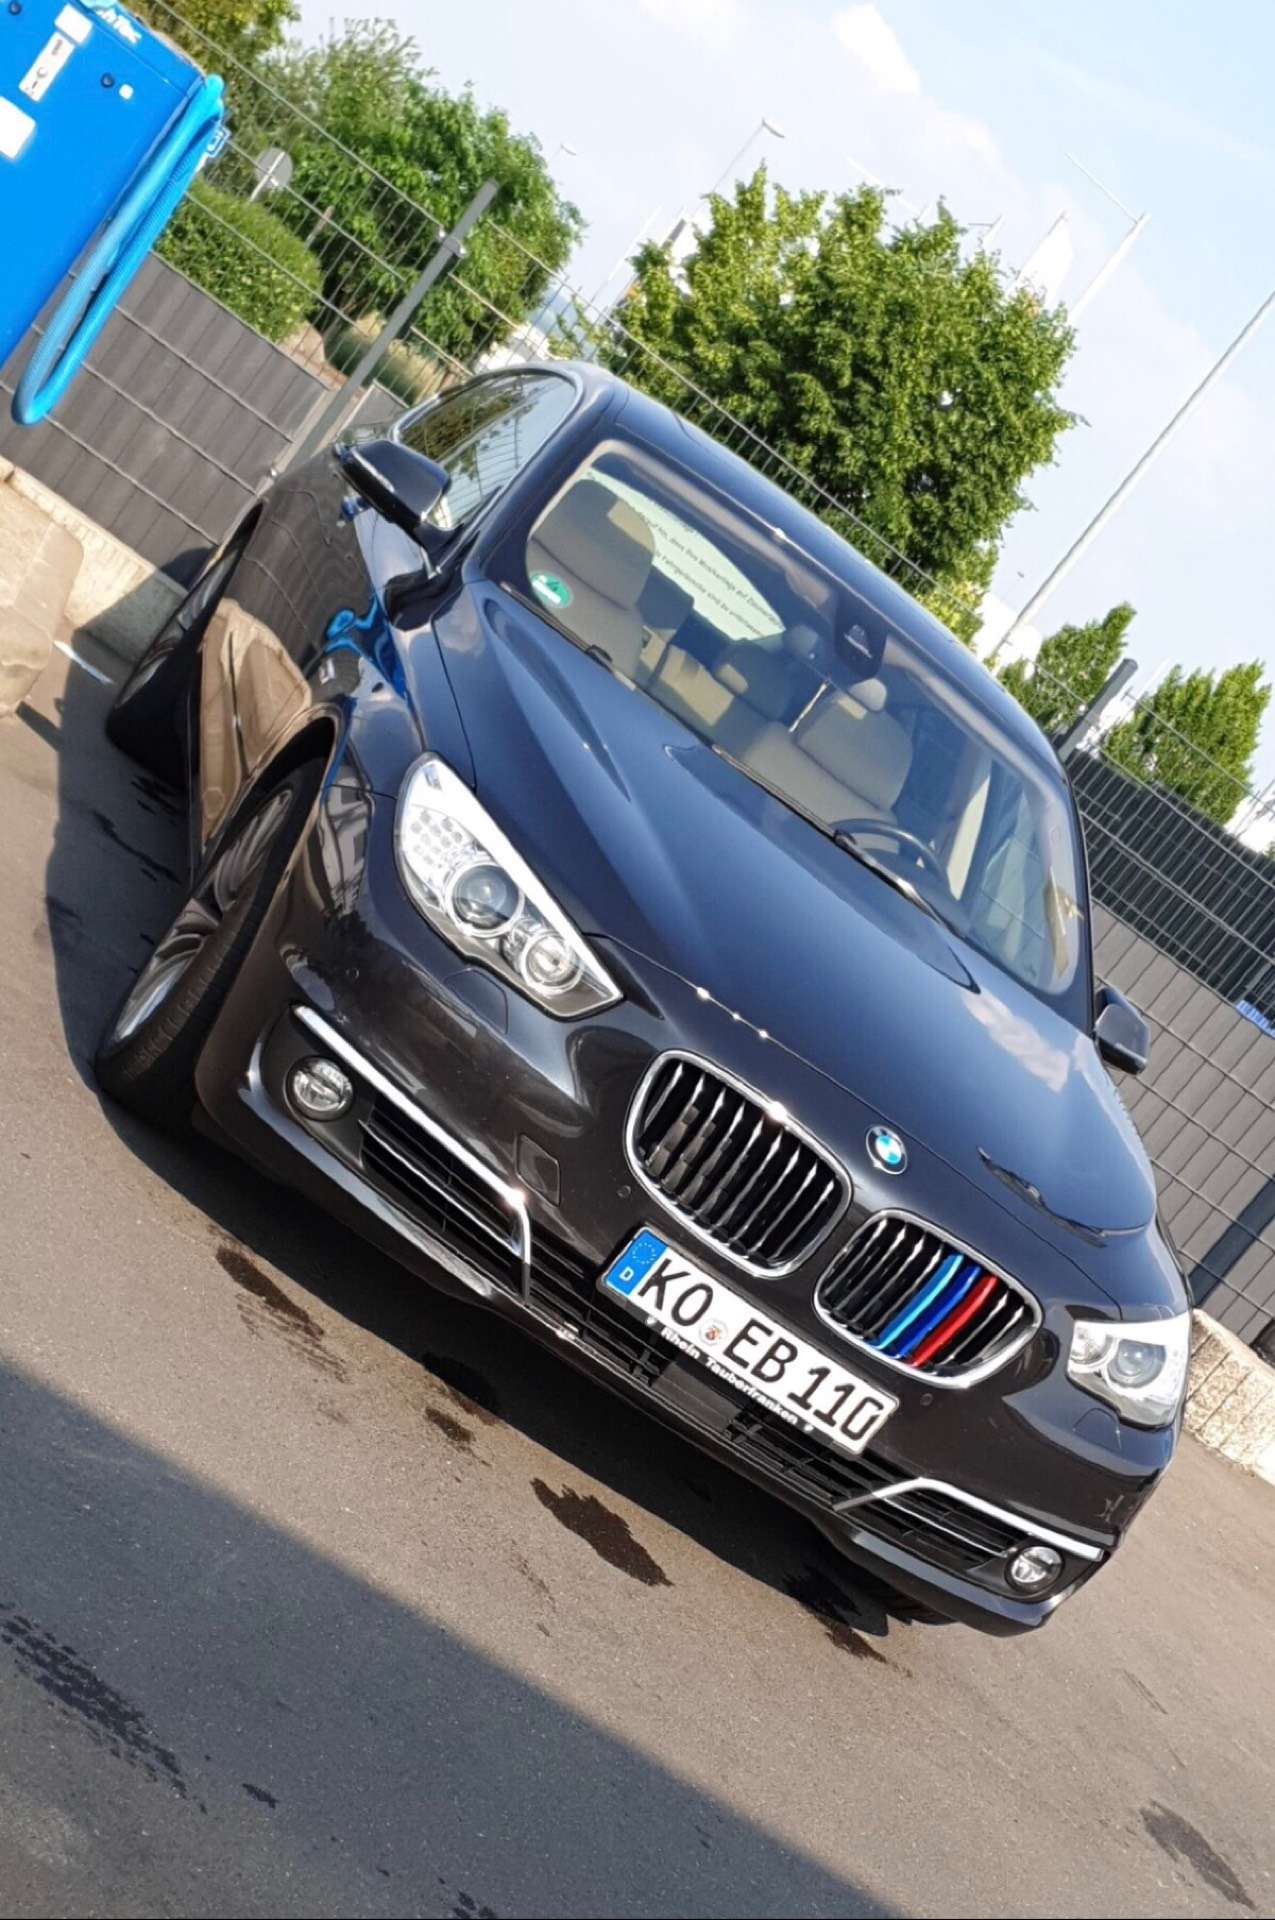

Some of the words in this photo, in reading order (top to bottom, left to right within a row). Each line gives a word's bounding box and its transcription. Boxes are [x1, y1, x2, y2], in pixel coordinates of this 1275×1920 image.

[618, 1267, 634, 1281] D
[637, 1258, 714, 1327] KO
[722, 1317, 798, 1383] EB
[786, 1366, 884, 1440] 110
[660, 1326, 701, 1360] Rhein
[704, 1356, 798, 1426] Tauberfranken
